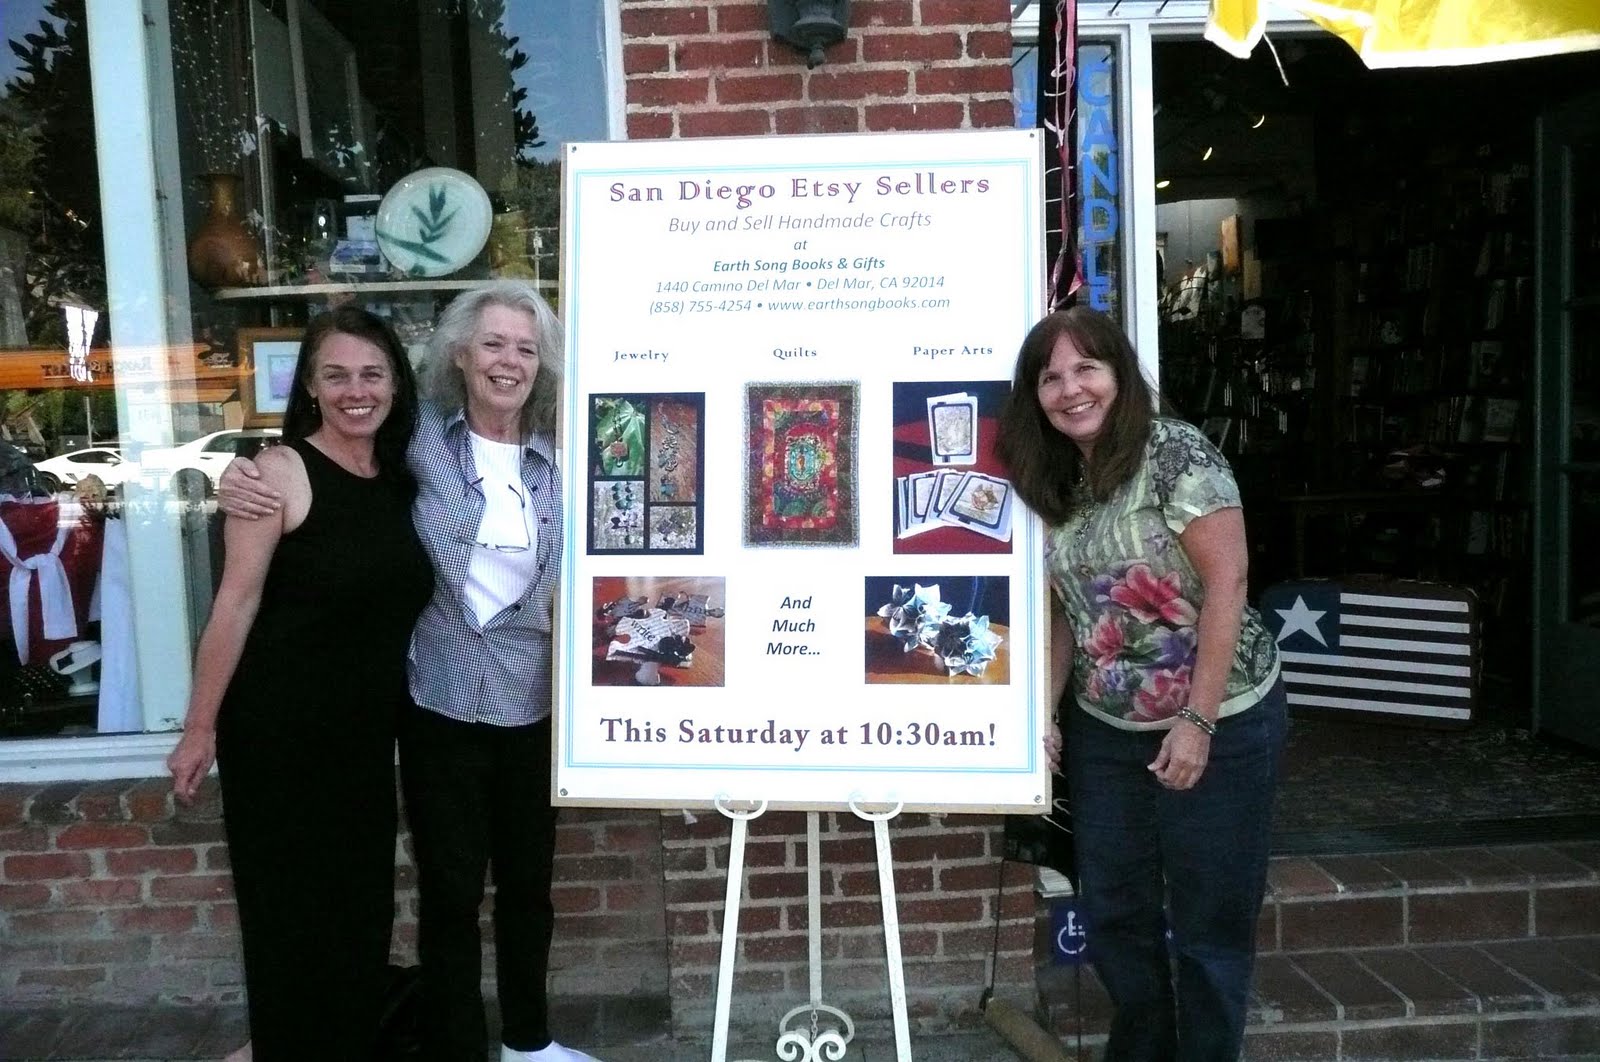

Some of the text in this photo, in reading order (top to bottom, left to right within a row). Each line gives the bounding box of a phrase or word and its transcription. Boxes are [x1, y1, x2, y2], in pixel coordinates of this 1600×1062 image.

[609, 172, 991, 210] San Diego Etsy Sellers
[668, 211, 932, 235] Buy and Sell Handmade Crafts
[793, 239, 808, 251] at
[713, 256, 886, 274] Earth Song Books & Gifts
[655, 275, 945, 293] 1440 Camino Del Mar Del Mar, CA 92014
[649, 297, 951, 315] (858) 755-4254 www.earthsongbooks.com
[614, 349, 670, 363] Jewelry
[773, 347, 818, 361] Quilts
[913, 344, 994, 360] Paper Arts
[780, 595, 812, 610] And
[630, 619, 656, 642] write
[772, 618, 816, 633] Much
[766, 641, 821, 657] More...
[600, 717, 997, 752] This Saturday at 10:30am!
